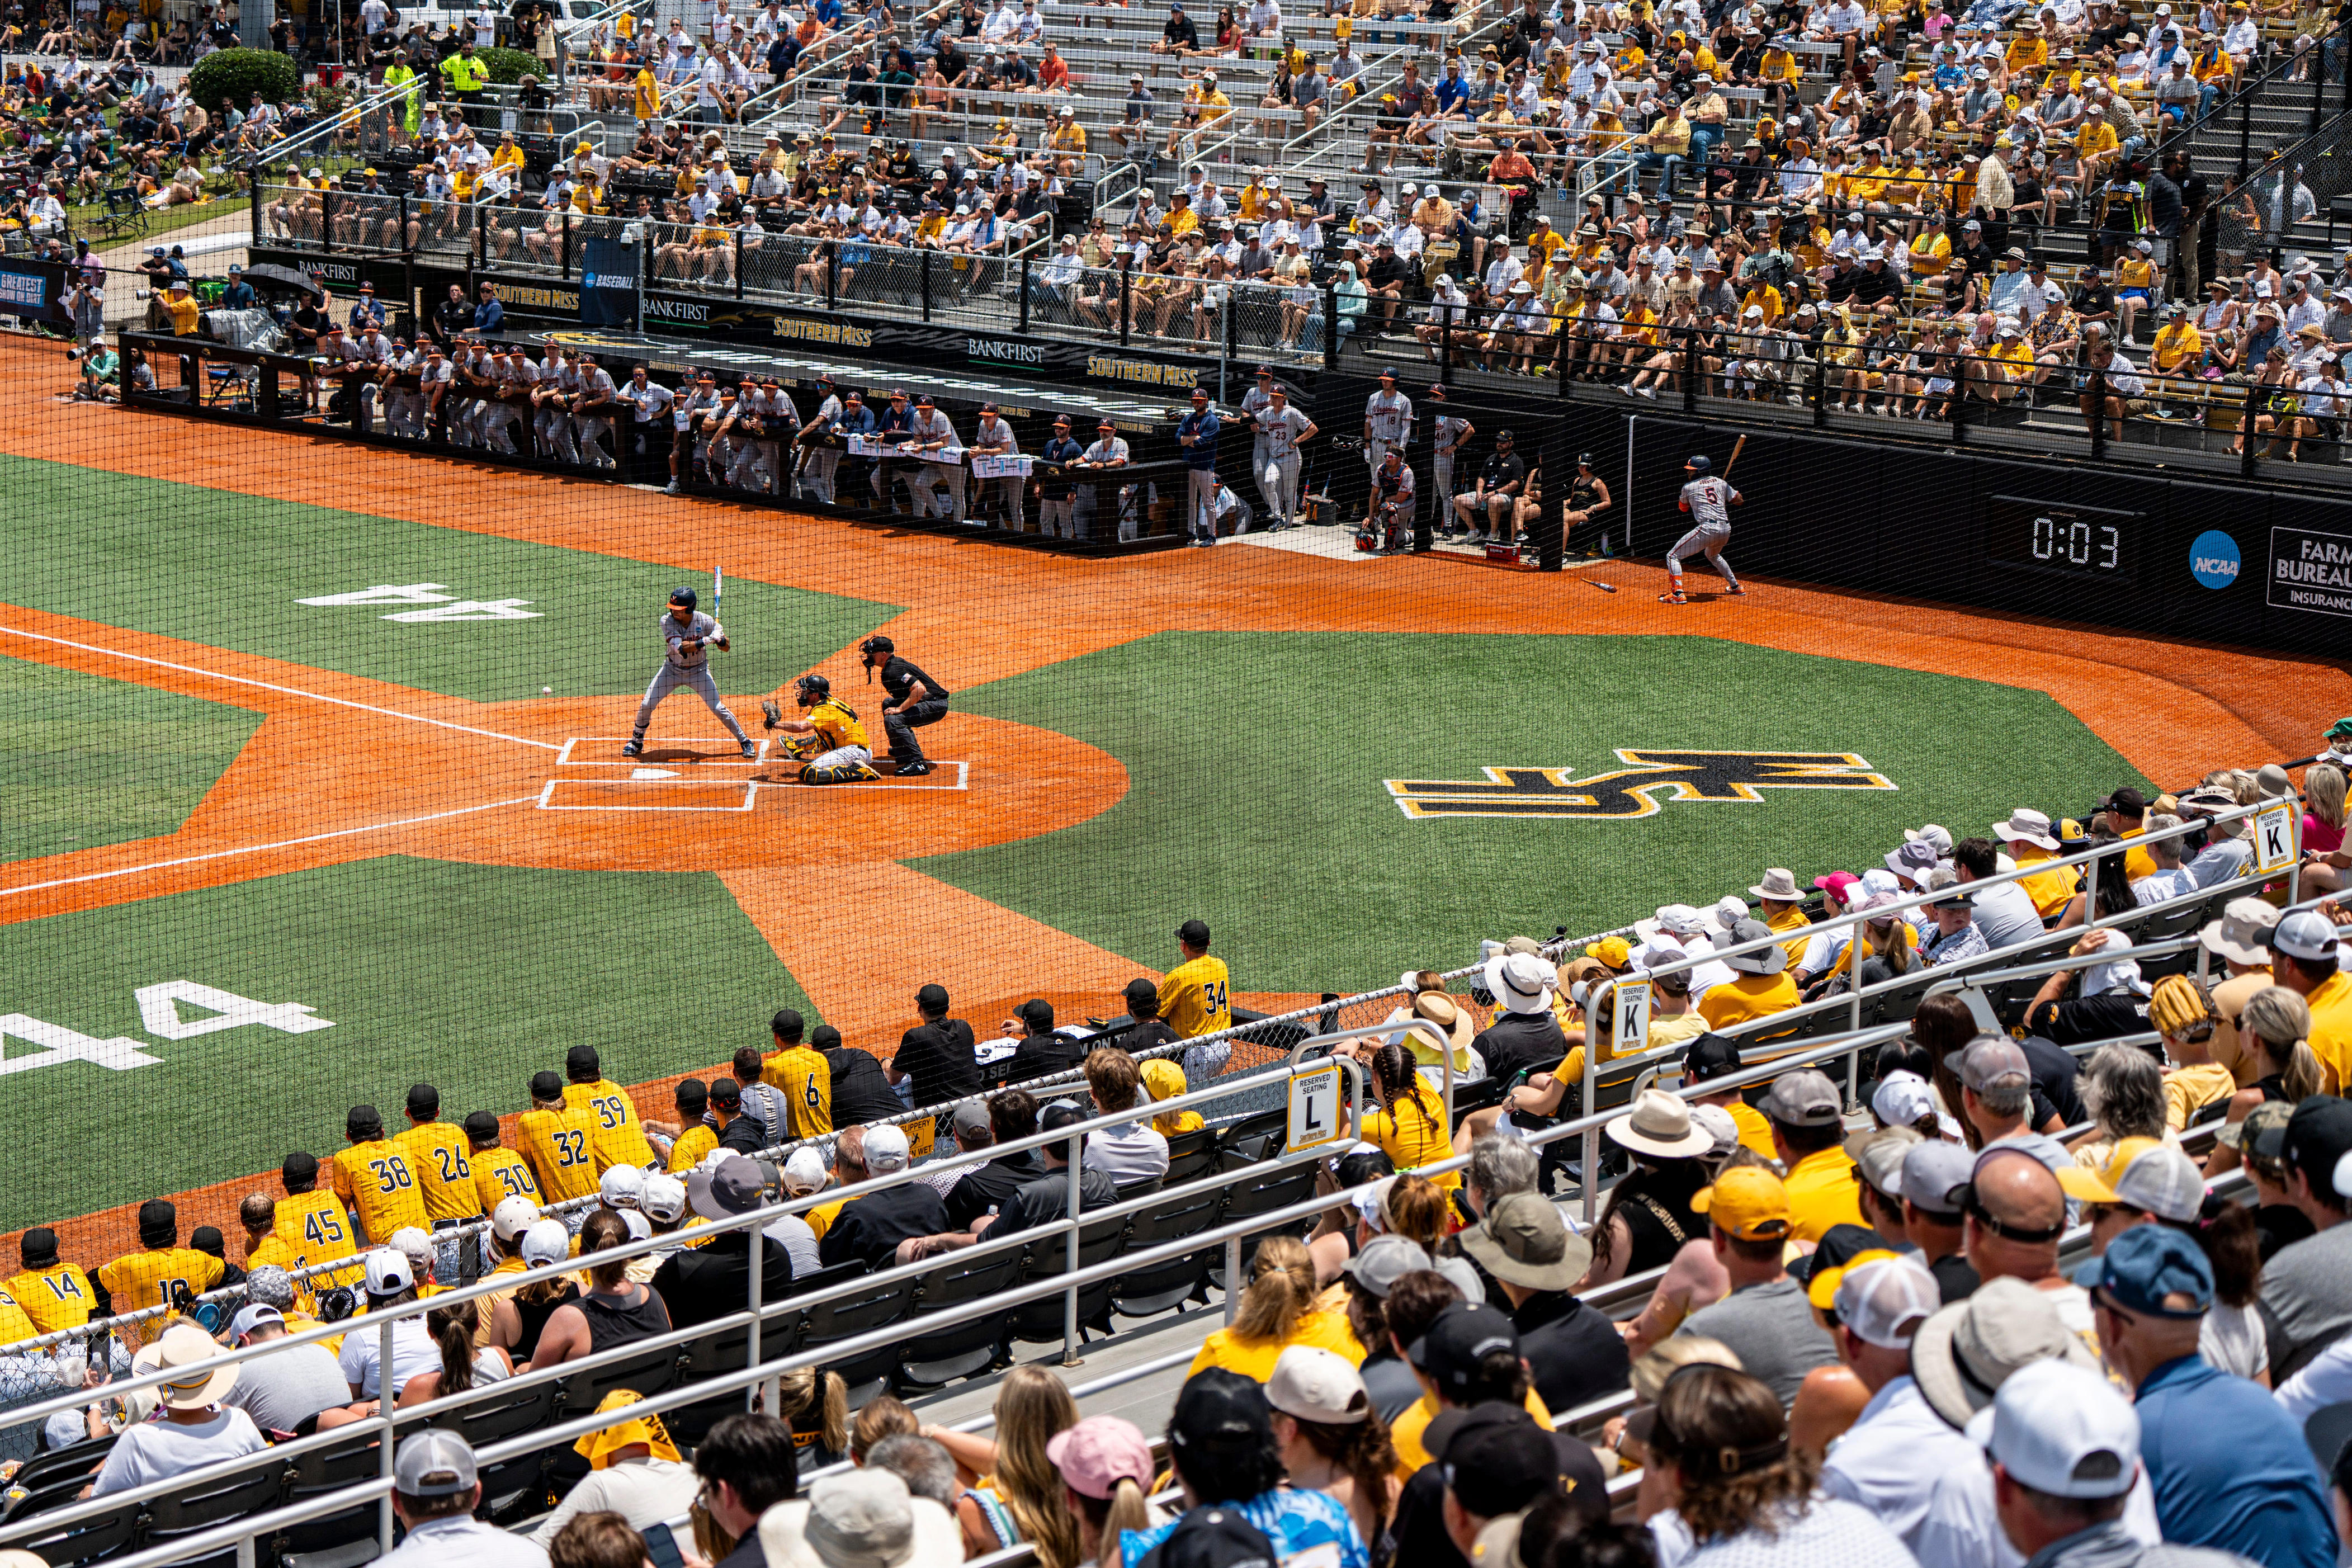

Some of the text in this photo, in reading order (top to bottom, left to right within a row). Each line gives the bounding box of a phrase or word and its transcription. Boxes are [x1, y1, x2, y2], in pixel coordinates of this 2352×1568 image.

[297, 261, 357, 281] BANKFIRST
[596, 275, 634, 289] BASEBALL
[1, 273, 43, 294] GREATEST
[17, 291, 25, 301] ON
[26, 292, 42, 305] DIRT
[493, 283, 579, 310] SOUTHERN MISS
[643, 298, 710, 321] BANKFIRST
[773, 317, 872, 347] SOUTHERN MISS
[968, 338, 1045, 363] BANKFIRST
[1087, 355, 1198, 388] SOUTHERN MISS
[1387, 416, 1395, 425] 18
[1275, 431, 1286, 440] 23
[1704, 487, 1717, 504] 5
[2033, 518, 2118, 568] 0:03
[2194, 557, 2238, 576] NCAA
[2260, 809, 2283, 823] RESERVED
[2263, 817, 2282, 828] SEATING
[2267, 826, 2283, 857] K
[1203, 980, 1227, 1015] 34
[1622, 986, 1645, 996] RESERVED
[1624, 995, 1642, 1003] SEATING
[1624, 1004, 1638, 1038] K
[805, 1072, 820, 1108] 6
[1298, 1072, 1330, 1088] RESERVED
[1301, 1083, 1328, 1095] SEATING
[591, 1095, 626, 1130] 39
[1306, 1096, 1321, 1130] L
[900, 1118, 931, 1133] SLIPPERY
[552, 1128, 589, 1168] 32
[918, 1145, 932, 1155] WET
[369, 1155, 413, 1194] 38
[433, 1143, 471, 1183] 26
[492, 1163, 537, 1198] 30
[304, 1208, 344, 1247] 45
[42, 1271, 83, 1301] 14
